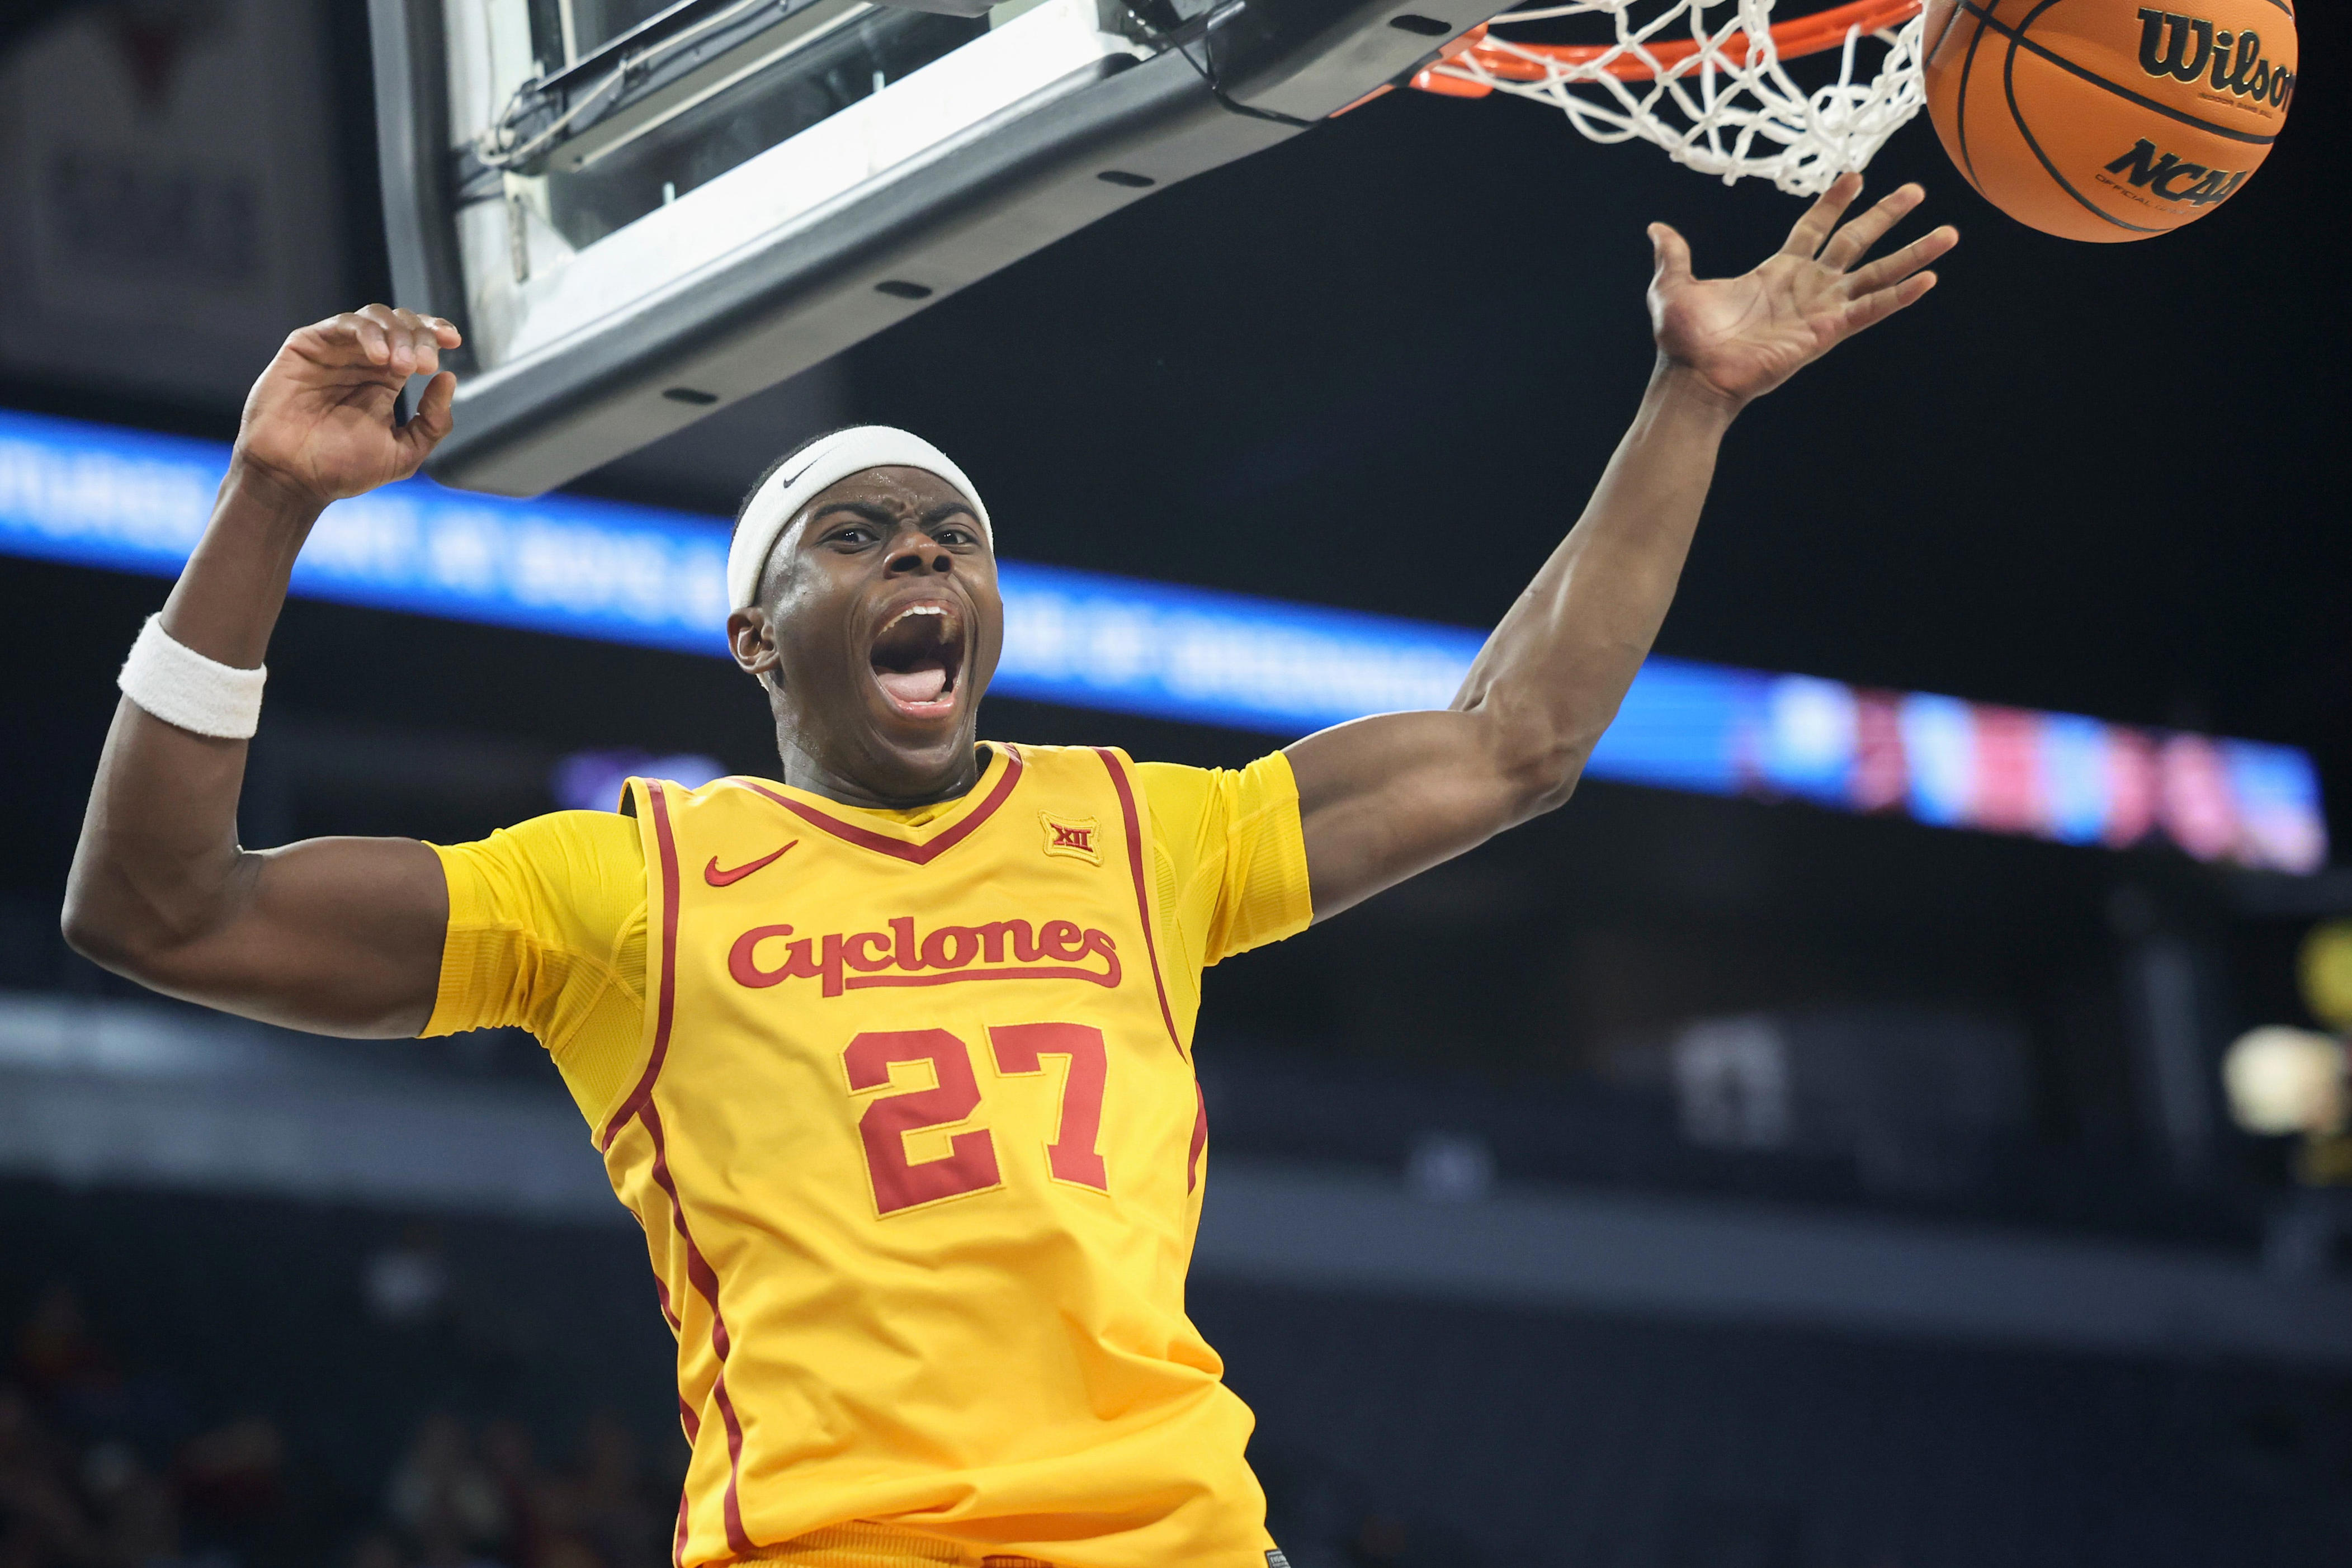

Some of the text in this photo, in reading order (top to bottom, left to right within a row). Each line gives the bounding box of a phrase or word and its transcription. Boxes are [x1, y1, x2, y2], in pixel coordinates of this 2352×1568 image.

[2095, 173, 2151, 206] OFFICIAL
[2104, 137, 2247, 207] NCAA
[1050, 823, 1094, 853] XII
[728, 916, 1122, 998] Cyclones
[839, 1022, 1110, 1220] 27
